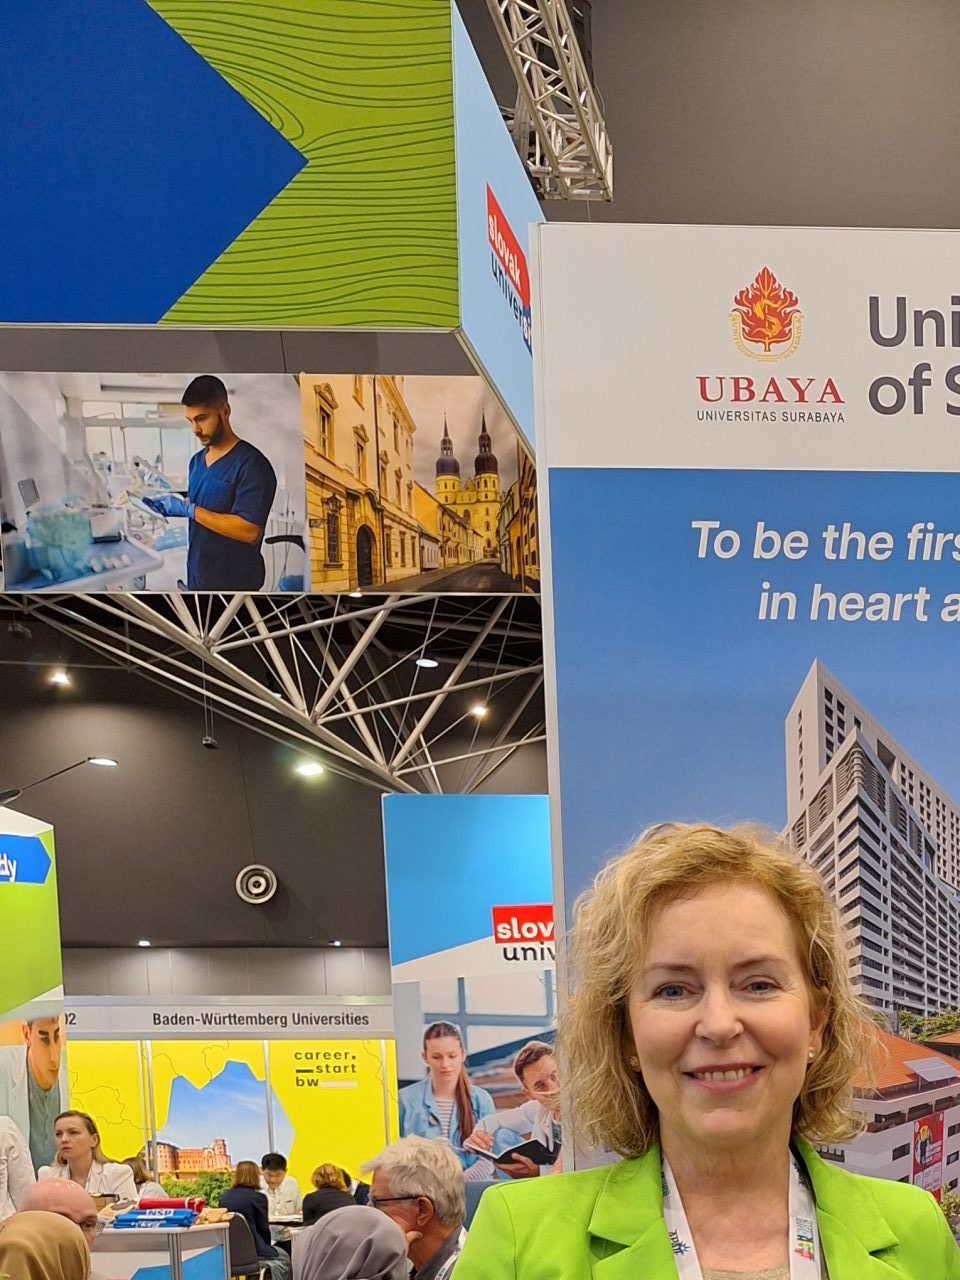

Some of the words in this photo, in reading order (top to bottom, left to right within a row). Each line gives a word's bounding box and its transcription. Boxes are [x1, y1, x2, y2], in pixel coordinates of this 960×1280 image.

[488, 214, 522, 291] slovak
[697, 376, 845, 404] UBAYA
[868, 363, 931, 416] of
[697, 410, 777, 422] UNIVERSITAS
[782, 411, 845, 423] SURABAYA
[692, 520, 741, 560] To
[753, 522, 809, 561] be
[823, 523, 894, 562] the
[758, 582, 797, 620] in
[810, 584, 931, 622] heart
[153, 1012, 288, 1028] Baden-Württemberg
[292, 1012, 370, 1026] Universities
[316, 1063, 357, 1074] start
